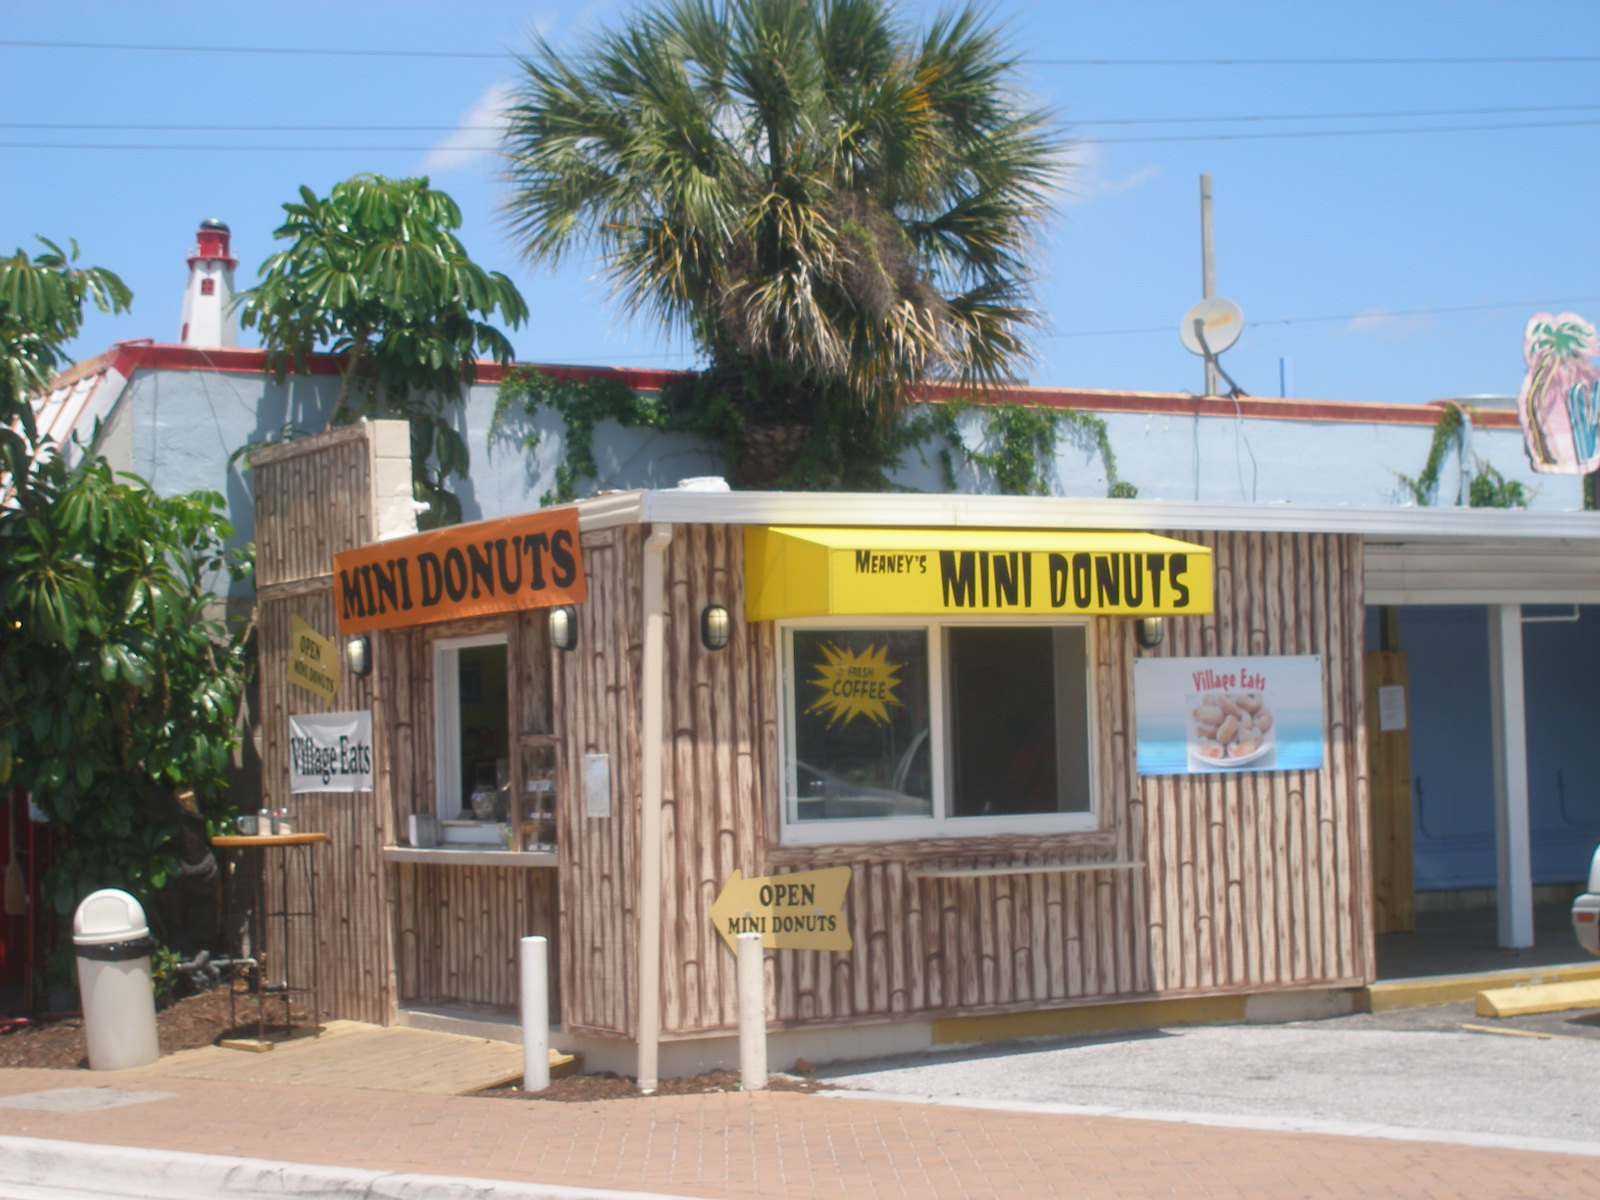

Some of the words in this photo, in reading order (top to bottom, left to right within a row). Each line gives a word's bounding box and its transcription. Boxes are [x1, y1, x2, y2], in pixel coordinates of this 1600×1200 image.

[340, 557, 413, 620] MINI
[417, 529, 576, 607] DONUTS
[939, 550, 1032, 608] MINI
[1048, 552, 1190, 609] DONUTS
[848, 665, 875, 678] FRESH
[1192, 668, 1236, 692] Village
[1240, 667, 1266, 691] Eats
[832, 679, 886, 700] COFFEE
[291, 736, 337, 785] Village
[340, 735, 371, 775] Eats
[759, 884, 815, 907] OPEN
[728, 916, 767, 934] MINI
[772, 915, 837, 933] DONUTS
